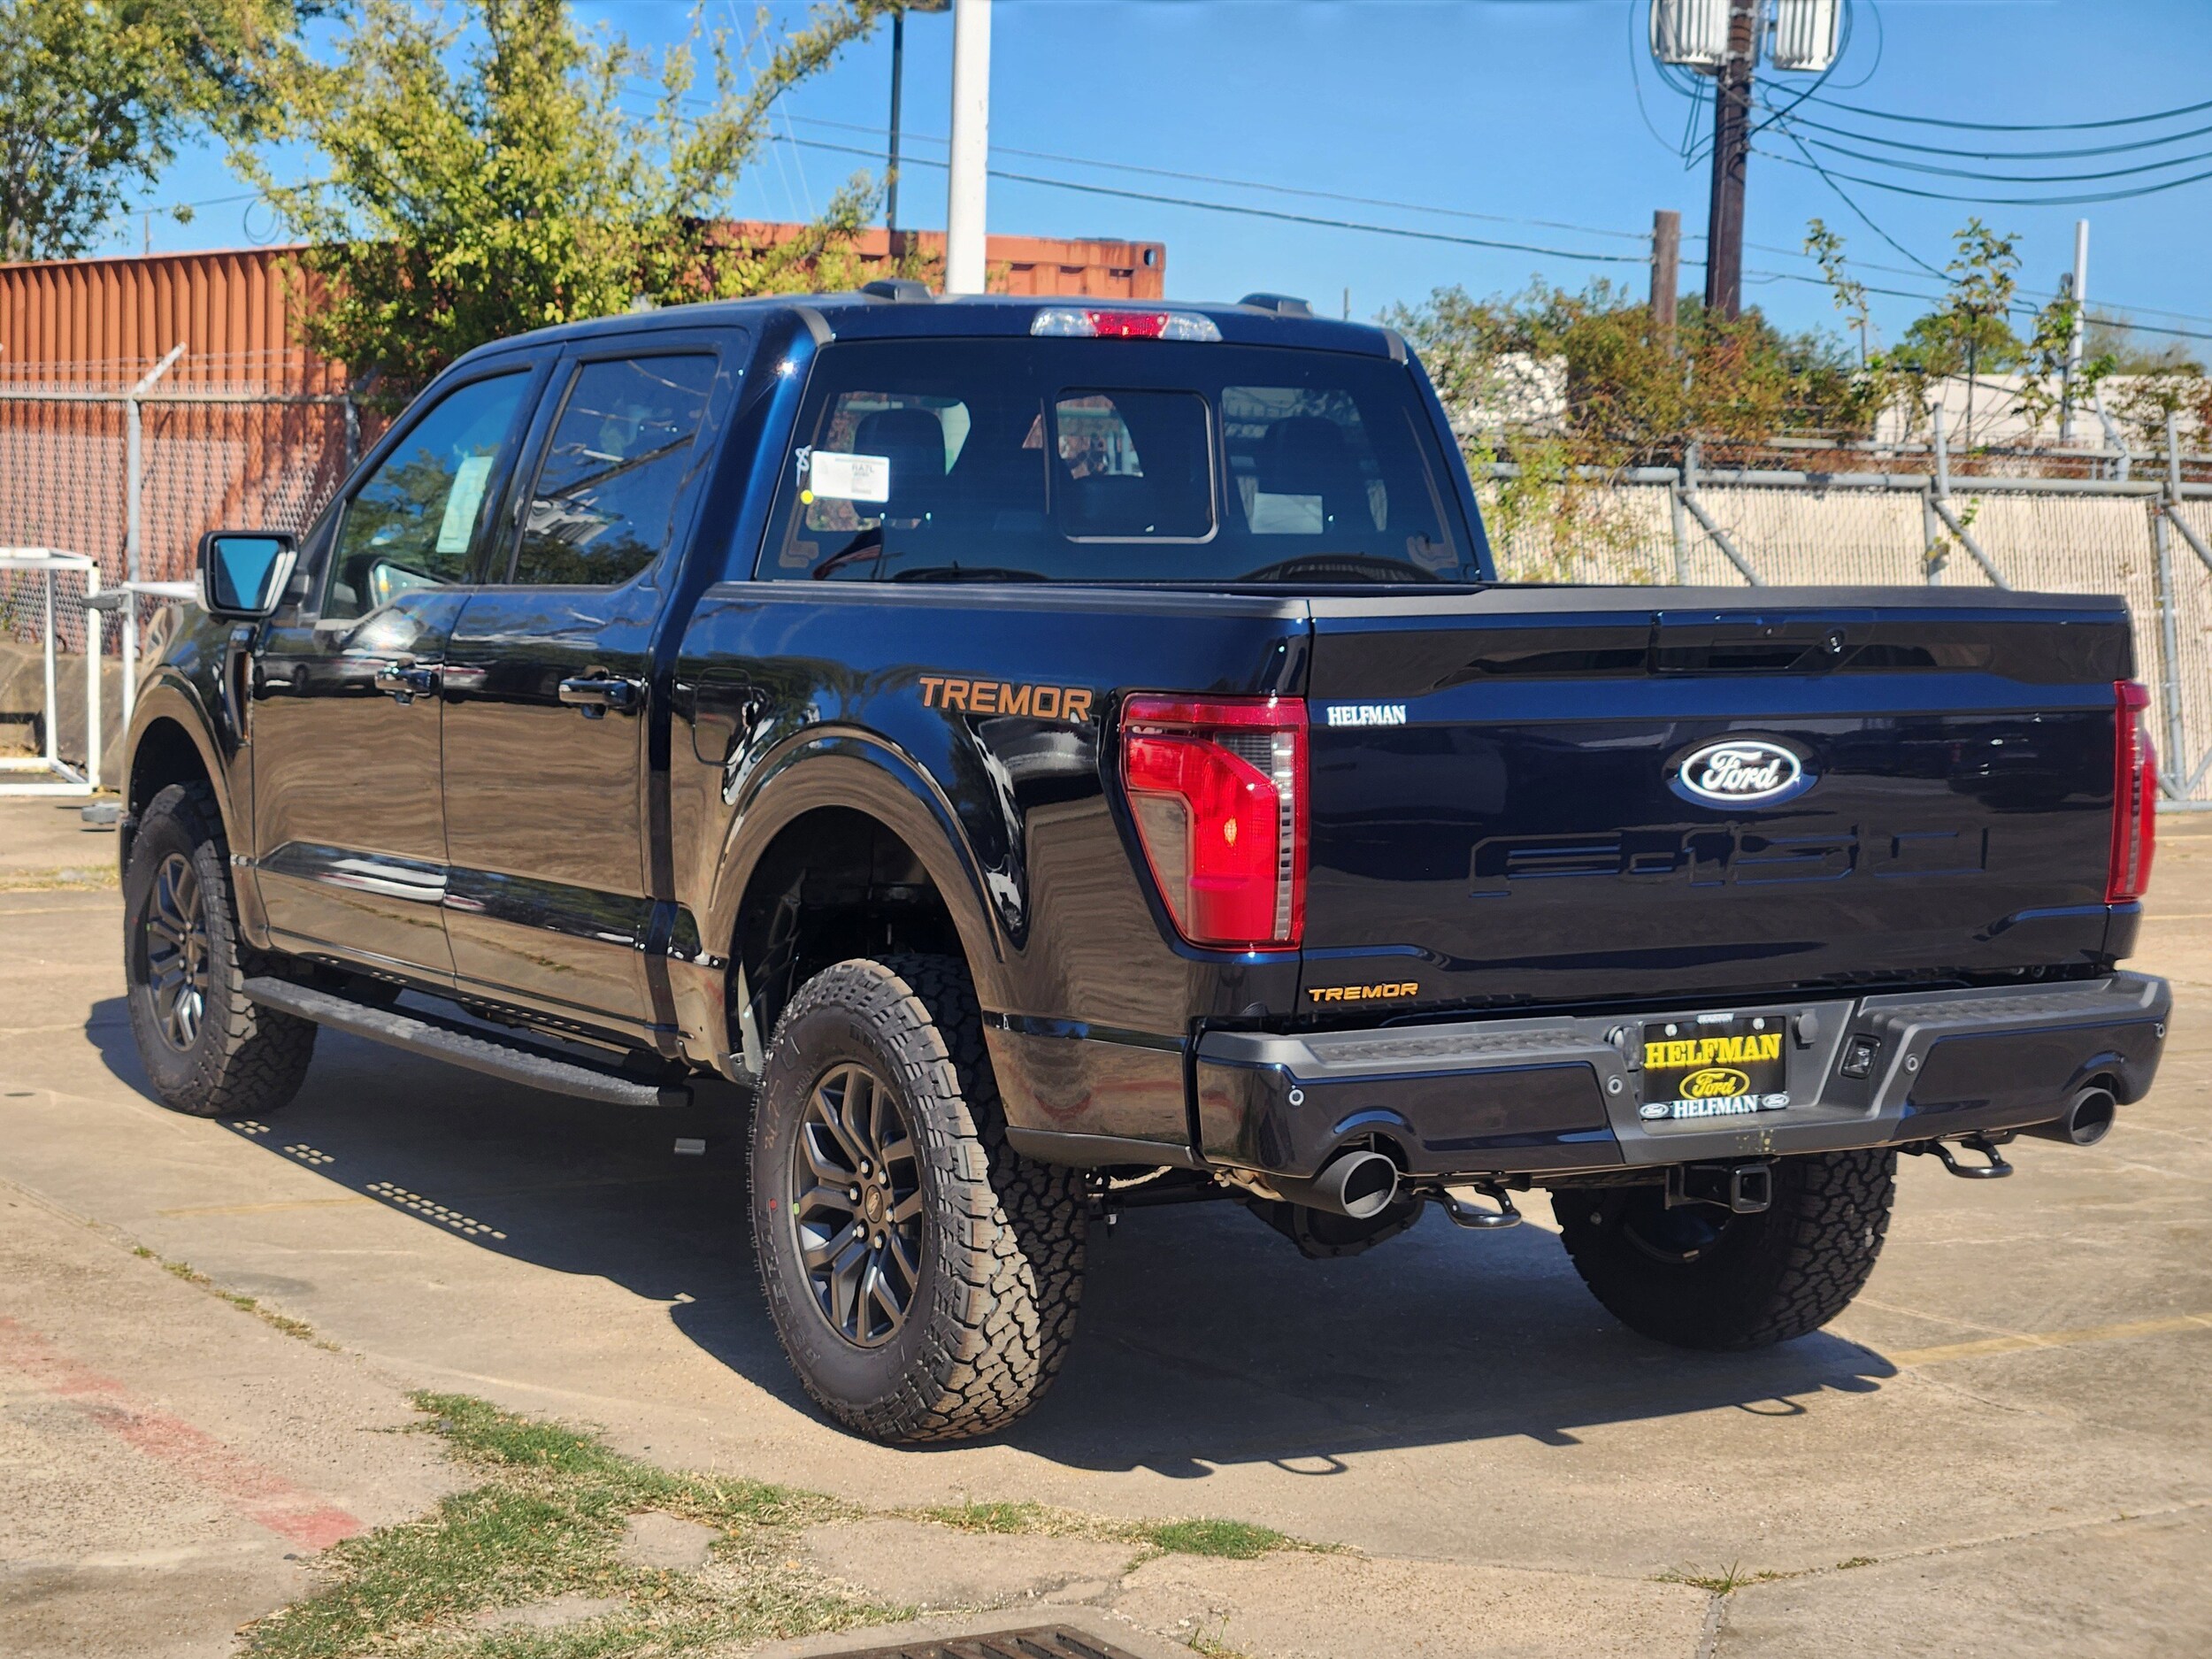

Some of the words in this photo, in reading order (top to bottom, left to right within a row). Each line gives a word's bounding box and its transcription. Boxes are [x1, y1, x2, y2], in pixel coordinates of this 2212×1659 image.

[919, 677, 1093, 721] TREMOR
[1326, 704, 1406, 727] HELFMAN
[1701, 750, 1781, 790] Ford
[1308, 982, 1419, 1002] TREMOR
[1643, 1033, 1783, 1070] HELFMAN
[1692, 1072, 1737, 1097] Ford
[1673, 1094, 1759, 1118] HELFMAN
